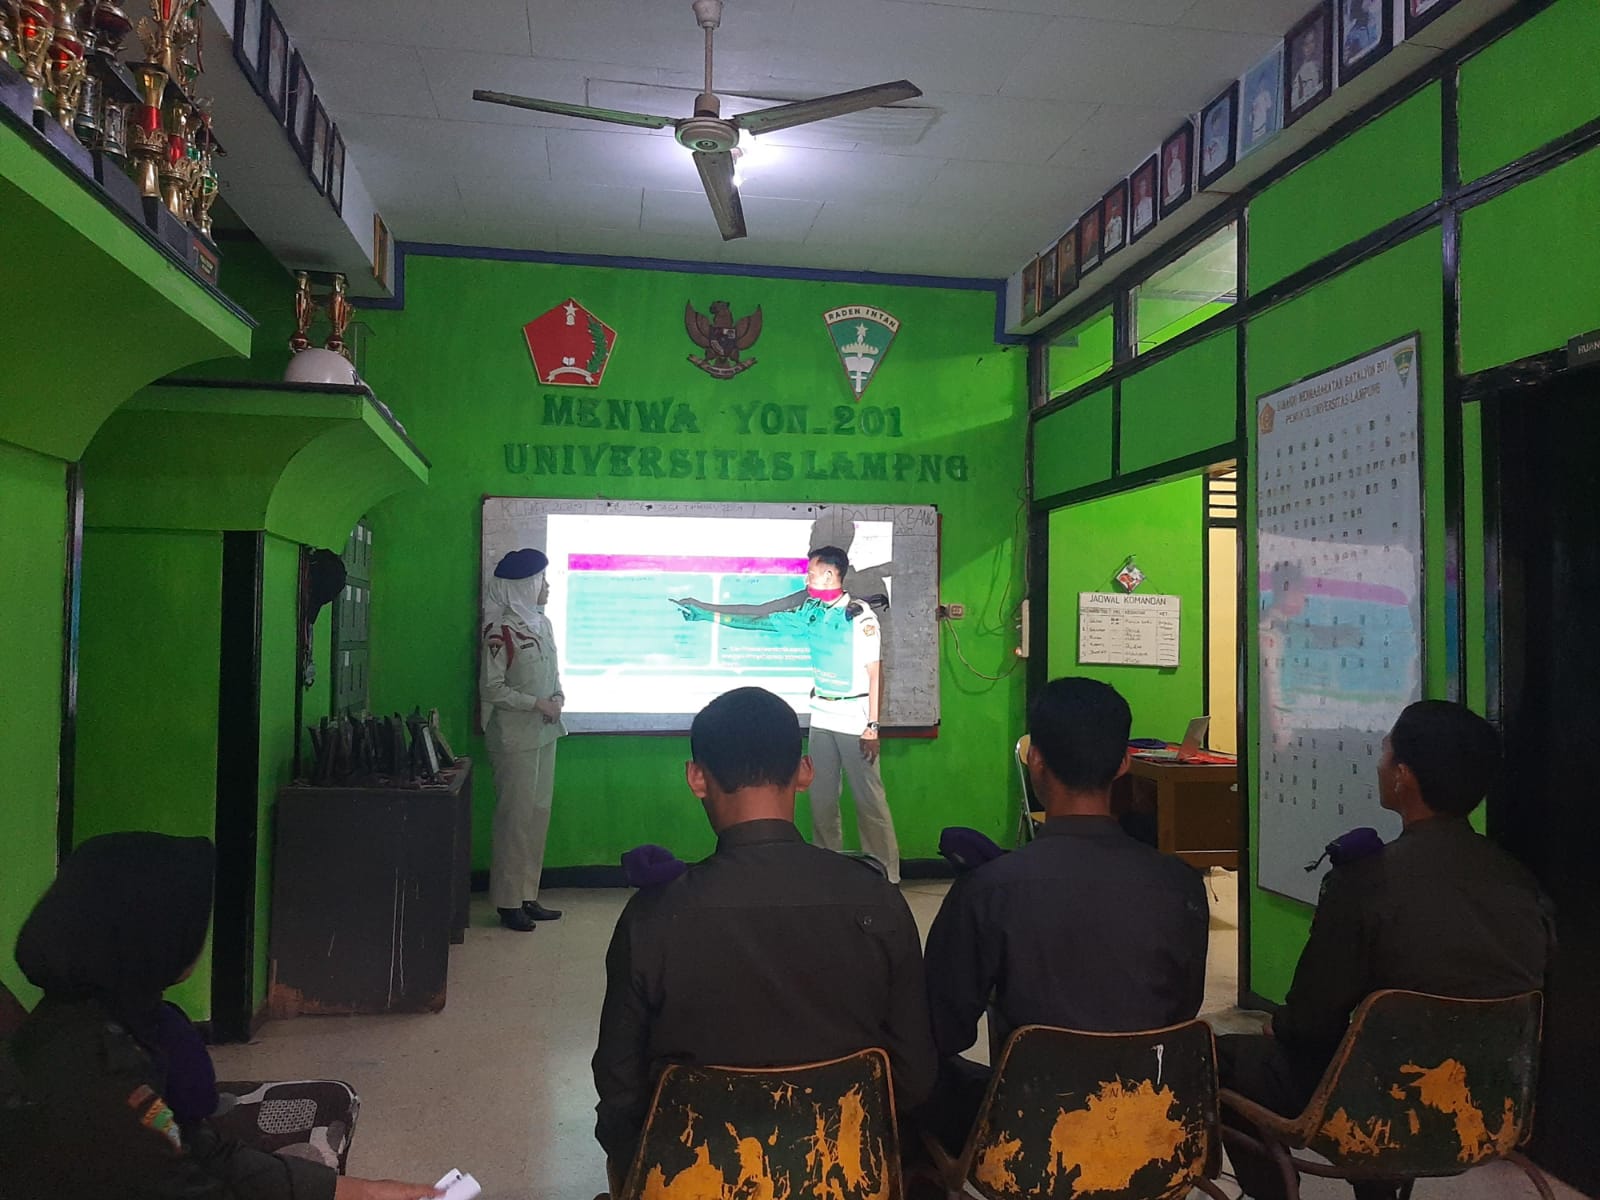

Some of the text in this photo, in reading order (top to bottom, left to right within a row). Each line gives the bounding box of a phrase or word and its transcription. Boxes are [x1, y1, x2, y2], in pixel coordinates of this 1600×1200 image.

[828, 308, 897, 328] RADEN INTAN
[541, 394, 700, 434] MENWA
[1089, 594, 1167, 606] JADWAL KOMANDAN
